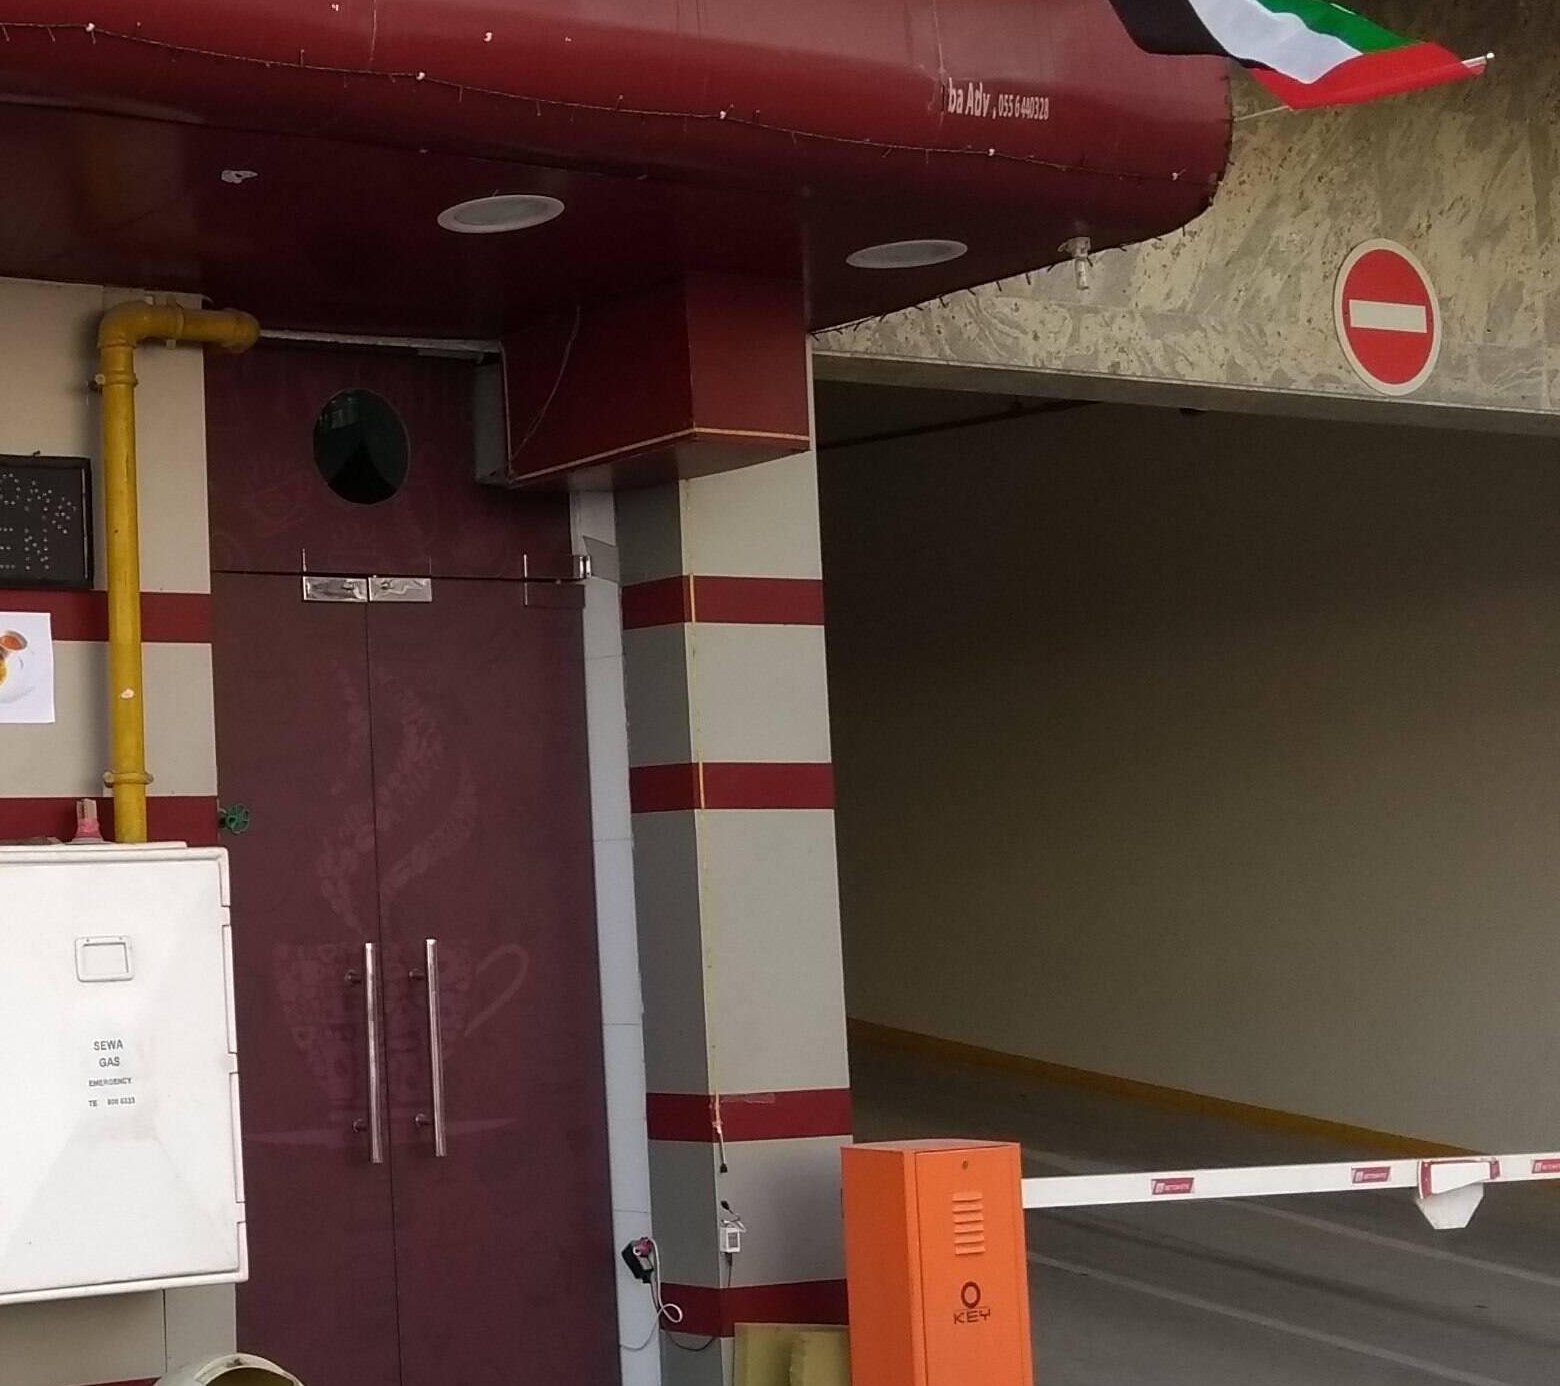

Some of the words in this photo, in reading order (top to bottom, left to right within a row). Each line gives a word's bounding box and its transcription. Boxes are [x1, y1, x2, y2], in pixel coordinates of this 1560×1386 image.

[93, 1038, 124, 1052] SEWA
[98, 1056, 121, 1068] GAS
[953, 1308, 991, 1325] KEY
